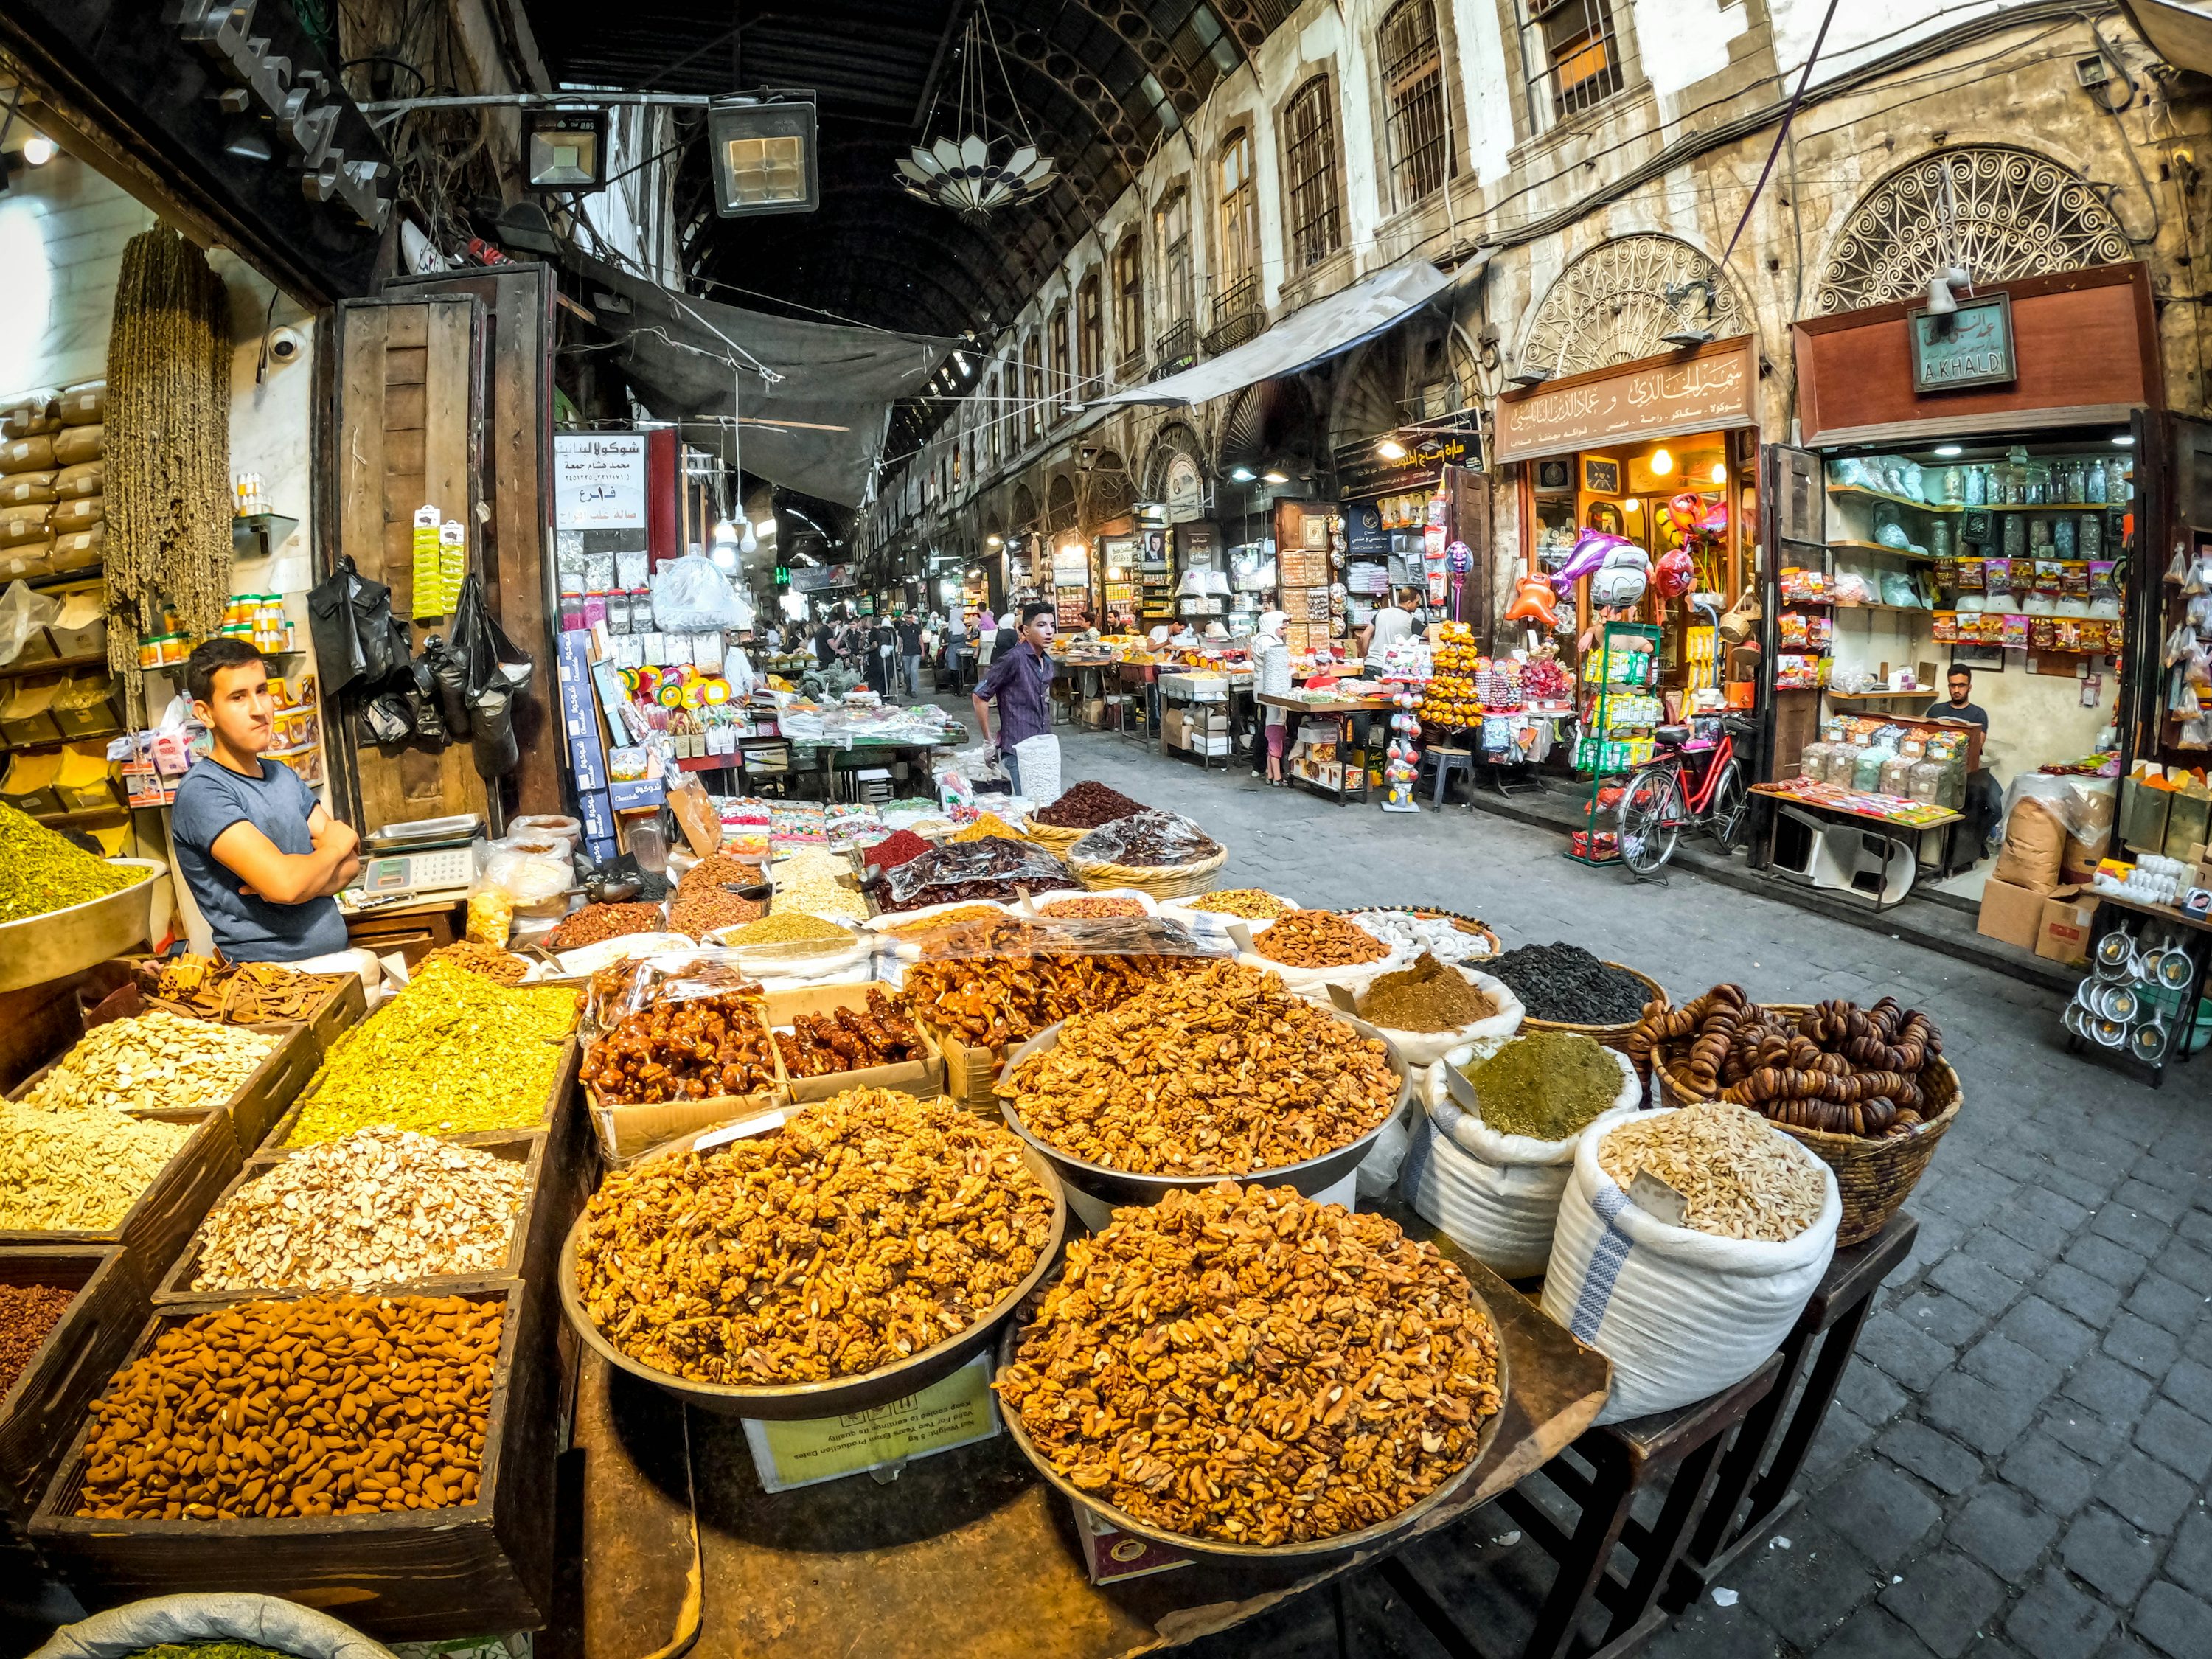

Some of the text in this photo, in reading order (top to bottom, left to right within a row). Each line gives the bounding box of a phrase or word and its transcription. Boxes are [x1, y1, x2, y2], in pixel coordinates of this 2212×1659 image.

[1694, 359, 1742, 397] سمير
[1628, 366, 1701, 407] الخالدي
[1601, 395, 1617, 416] و
[1710, 397, 1742, 414] شوكولا
[1640, 414, 1662, 423] راحة
[1670, 408, 1702, 421] سكاكر
[594, 441, 639, 456] شوكولا
[565, 461, 585, 471] جمعة
[588, 461, 606, 470] هشام
[613, 507, 636, 519] صالة
[563, 633, 573, 661] شوكولا
[568, 685, 580, 714] شوكولا
[576, 740, 588, 769] شوكولا
[634, 782, 661, 794] شوكولا
[614, 793, 639, 802] Chocolate
[593, 842, 602, 863] وكولا
[950, 1400, 971, 1411] Keep
[921, 1408, 948, 1421] cooled
[953, 1410, 973, 1420] Valid
[893, 1427, 917, 1436] Years
[918, 1422, 935, 1430] Two
[827, 1430, 856, 1442] quality
[908, 1434, 919, 1442] kg
[820, 1439, 867, 1454] Production
[793, 1450, 818, 1460] Dates
